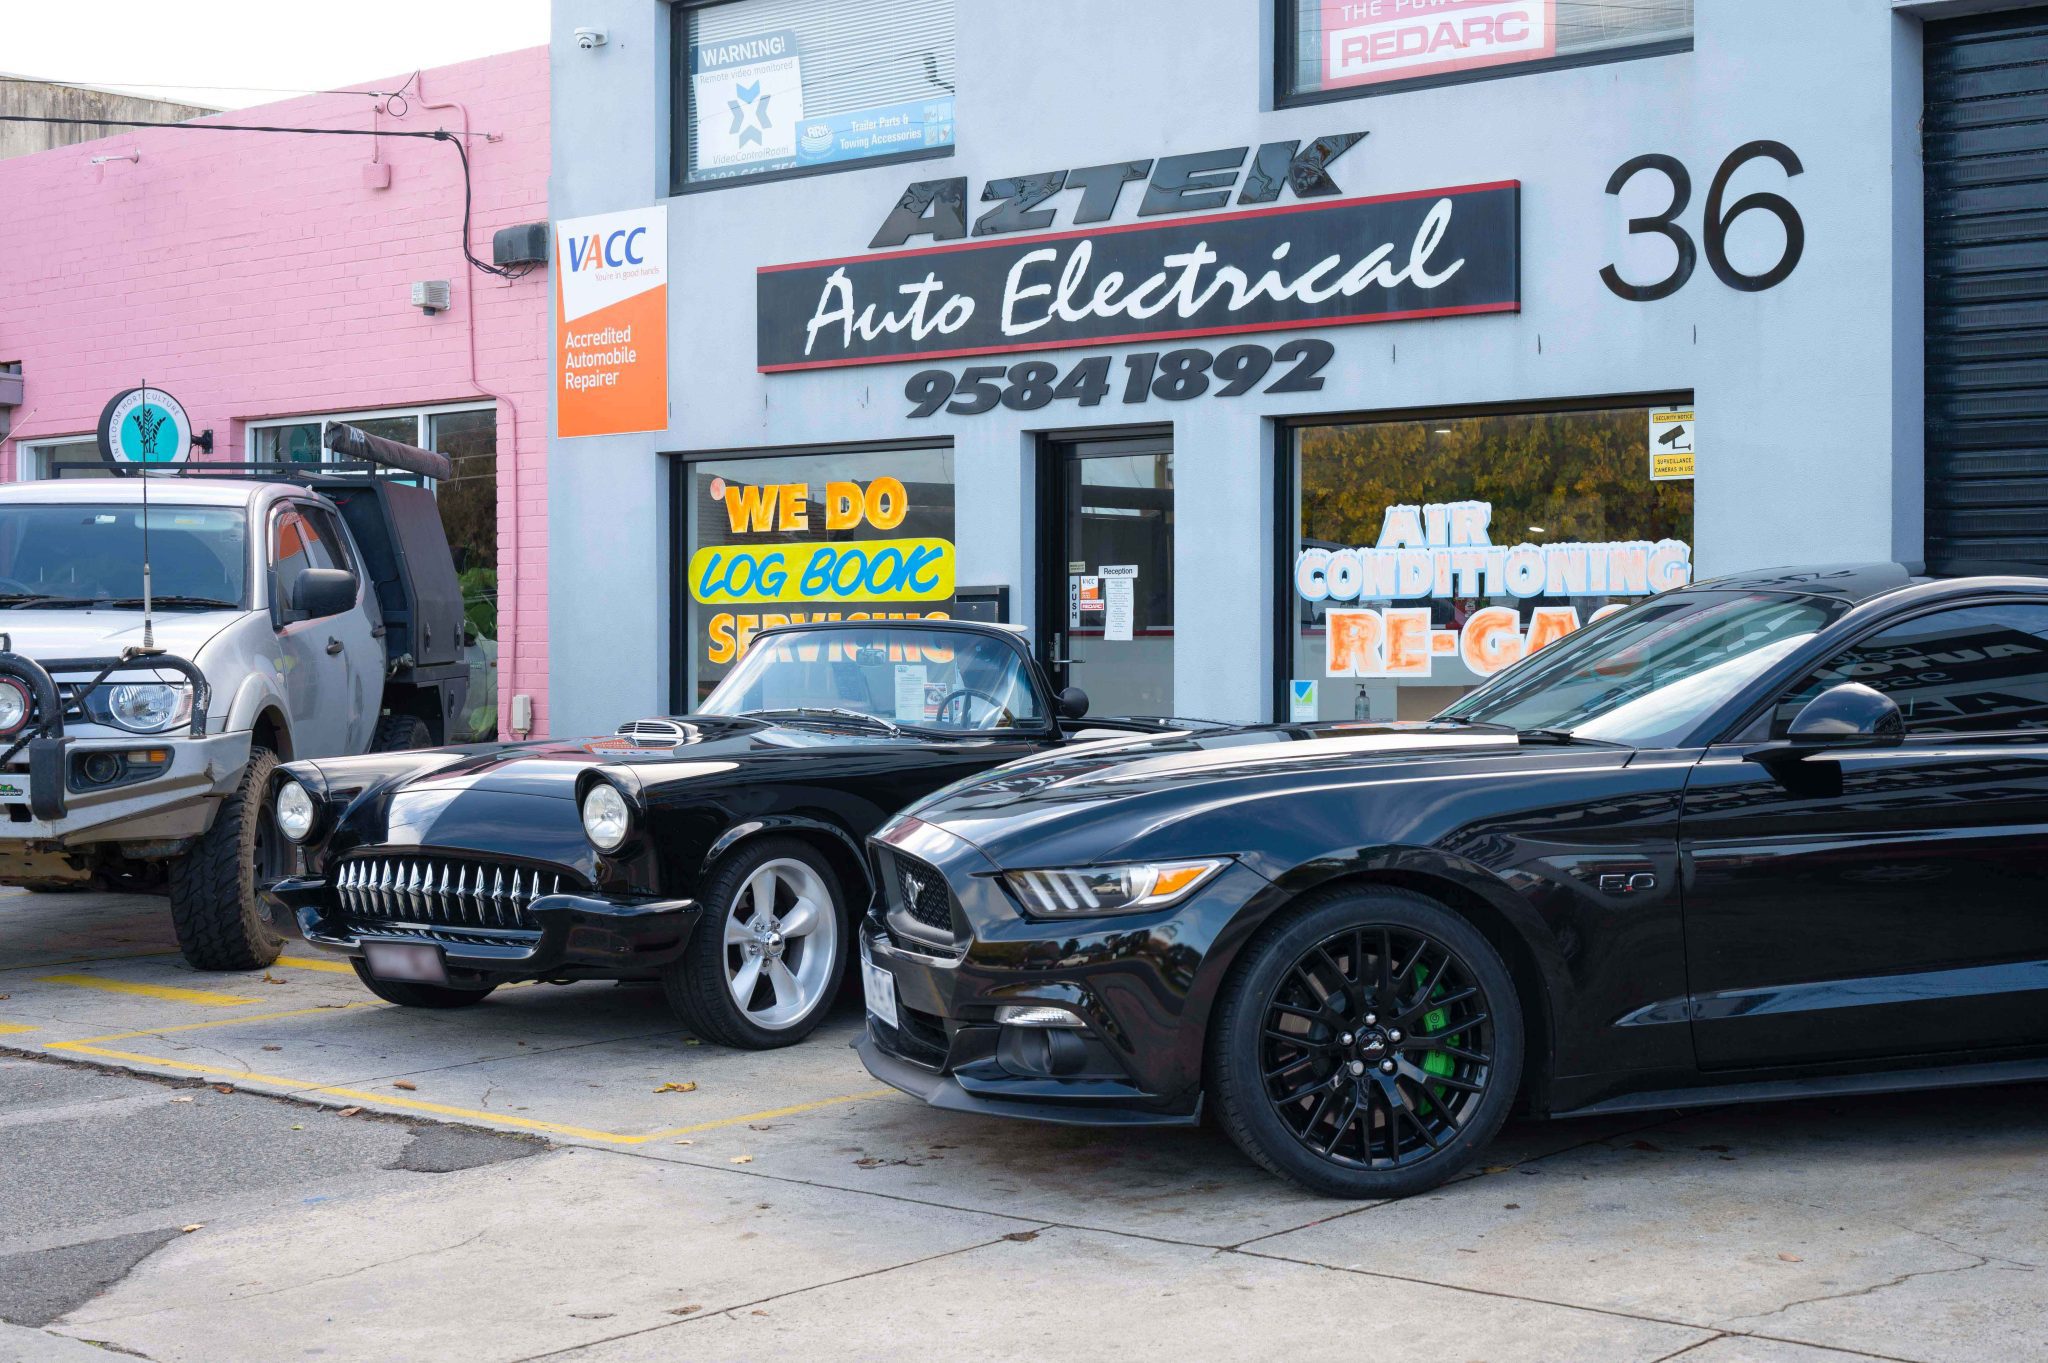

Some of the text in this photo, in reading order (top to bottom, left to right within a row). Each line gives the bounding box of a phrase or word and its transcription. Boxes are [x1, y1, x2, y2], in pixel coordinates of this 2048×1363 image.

[1341, 3, 1382, 22] THE
[702, 36, 786, 67] WARNING!
[1341, 10, 1529, 68] REDARC
[700, 60, 793, 85] Remote video monitored
[840, 128, 922, 150] Towing Accessories
[852, 120, 877, 133] Trailer
[879, 116, 900, 128] Parts
[868, 130, 1369, 249] AZTEK
[1599, 139, 1804, 302] 36
[568, 226, 647, 273] VACC
[804, 198, 1464, 356] Auto Electrical
[565, 325, 631, 349] Accredited
[565, 346, 637, 369] Automobile
[565, 369, 620, 393] Repairer
[904, 338, 1335, 419] 9584 1892
[122, 392, 181, 416] HORTCULTURE
[724, 476, 908, 534] WE DO
[1376, 500, 1493, 549] AIR
[699, 544, 944, 598] LOG BOOK
[1103, 567, 1133, 576] Reception
[1295, 538, 1692, 602] CONDITIONING
